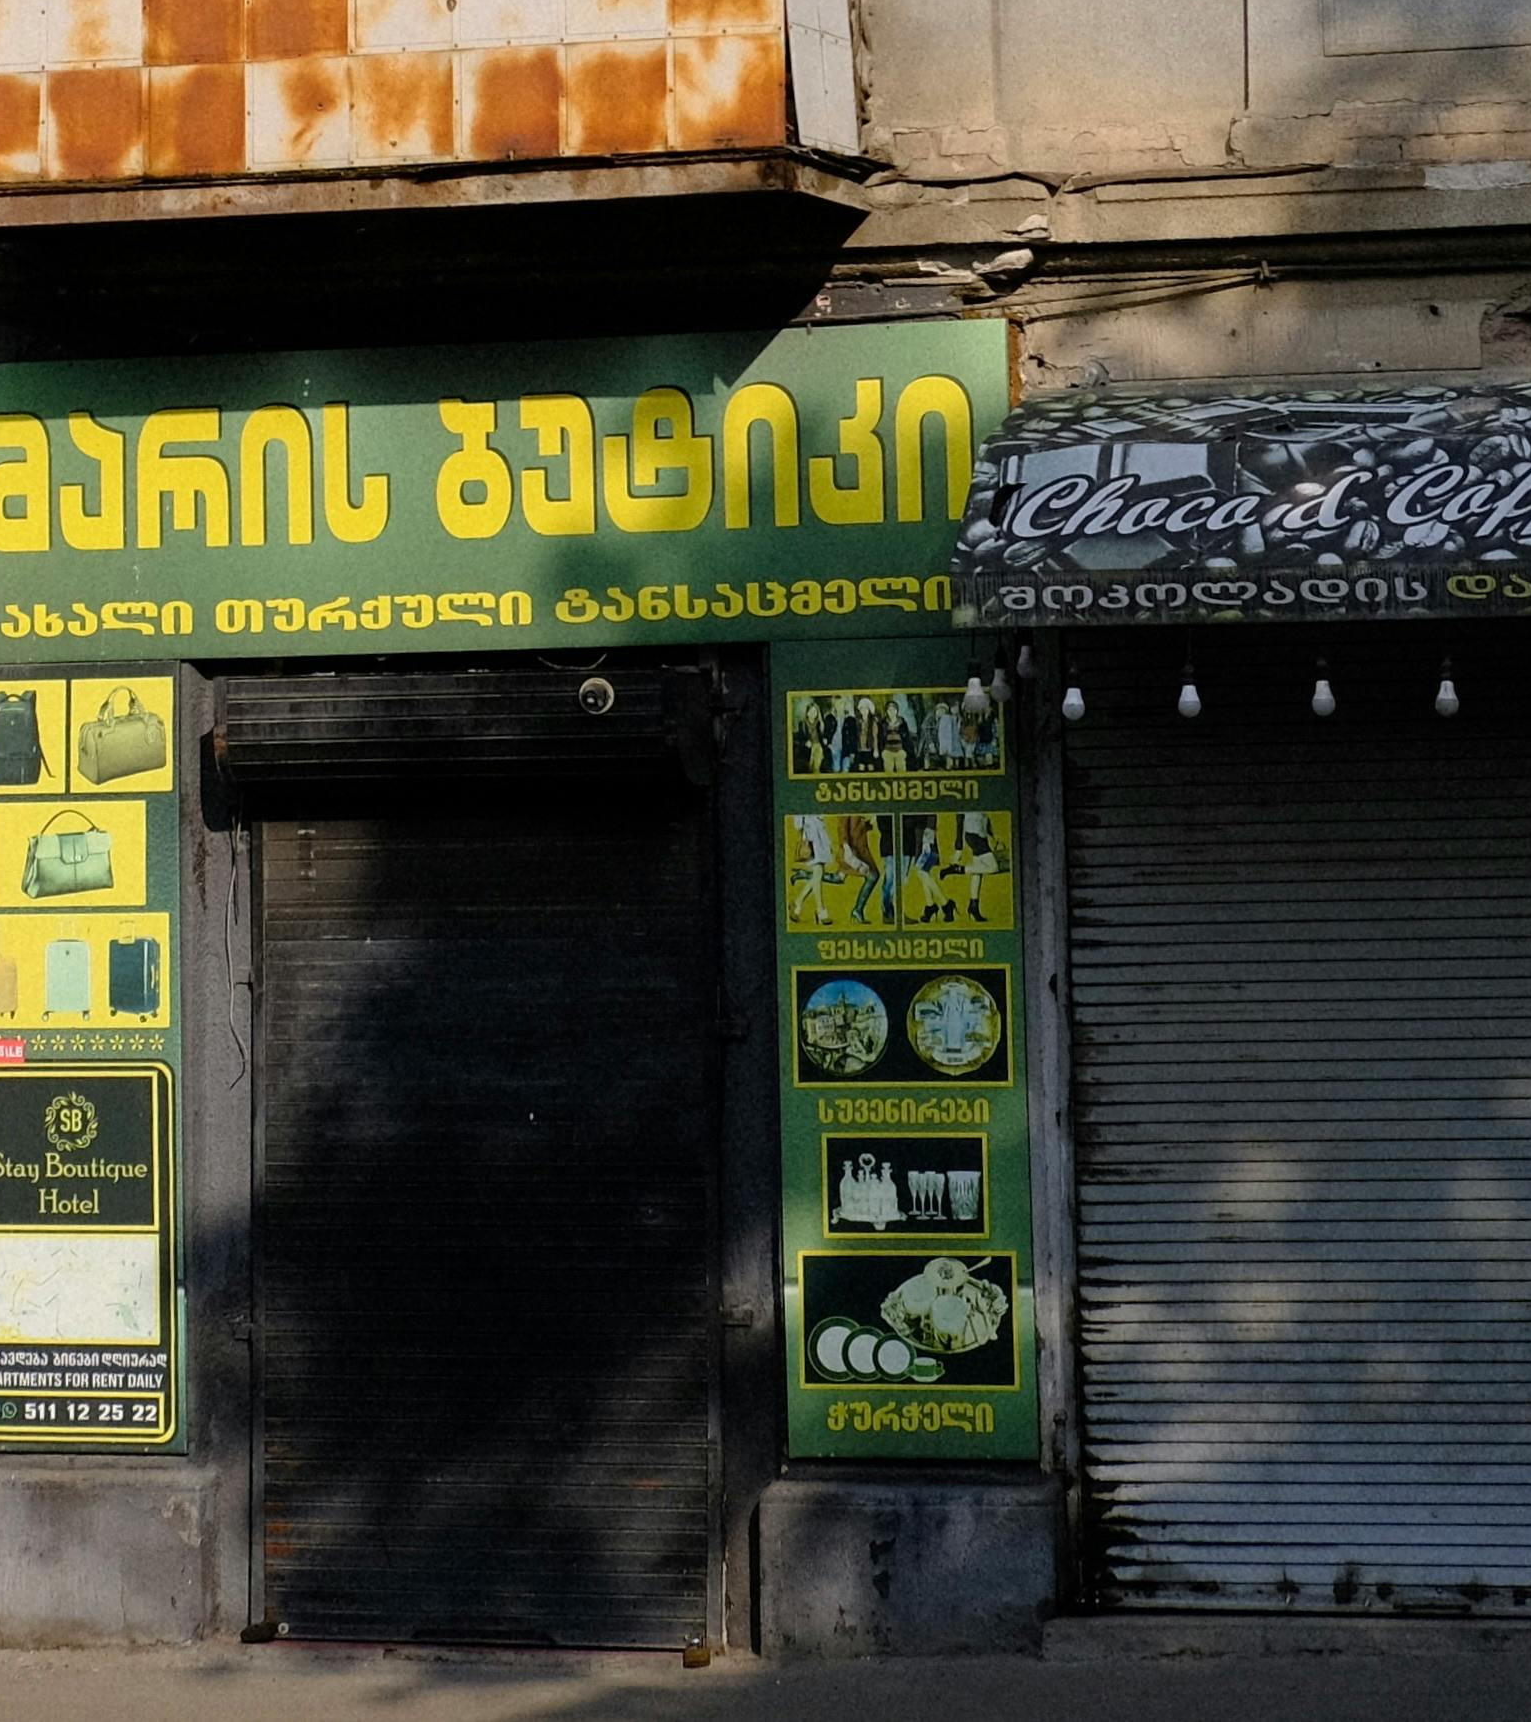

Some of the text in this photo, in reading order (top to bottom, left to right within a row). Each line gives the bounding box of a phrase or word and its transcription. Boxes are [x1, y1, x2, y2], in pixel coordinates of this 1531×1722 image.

[433, 374, 973, 542] ბუტიკი
[1007, 474, 1255, 538] Choco
[212, 589, 534, 637] თურქული
[554, 574, 953, 625] ტანსაცმელი
[997, 573, 1429, 612] შოკოლადის
[814, 779, 980, 803] ტანსაცმელი
[816, 937, 986, 961] ფეხსაცმელი
[59, 1108, 83, 1133] SB
[817, 1098, 991, 1126] სუვენირები
[44, 1152, 149, 1184] Boutique
[38, 1188, 100, 1215] Hotel
[65, 1373, 89, 1387] FOR
[92, 1373, 125, 1388] RENT
[127, 1373, 164, 1389] DAILY
[24, 1402, 156, 1421] 511 12 25 22
[826, 1400, 995, 1433] ჭურჭელი
